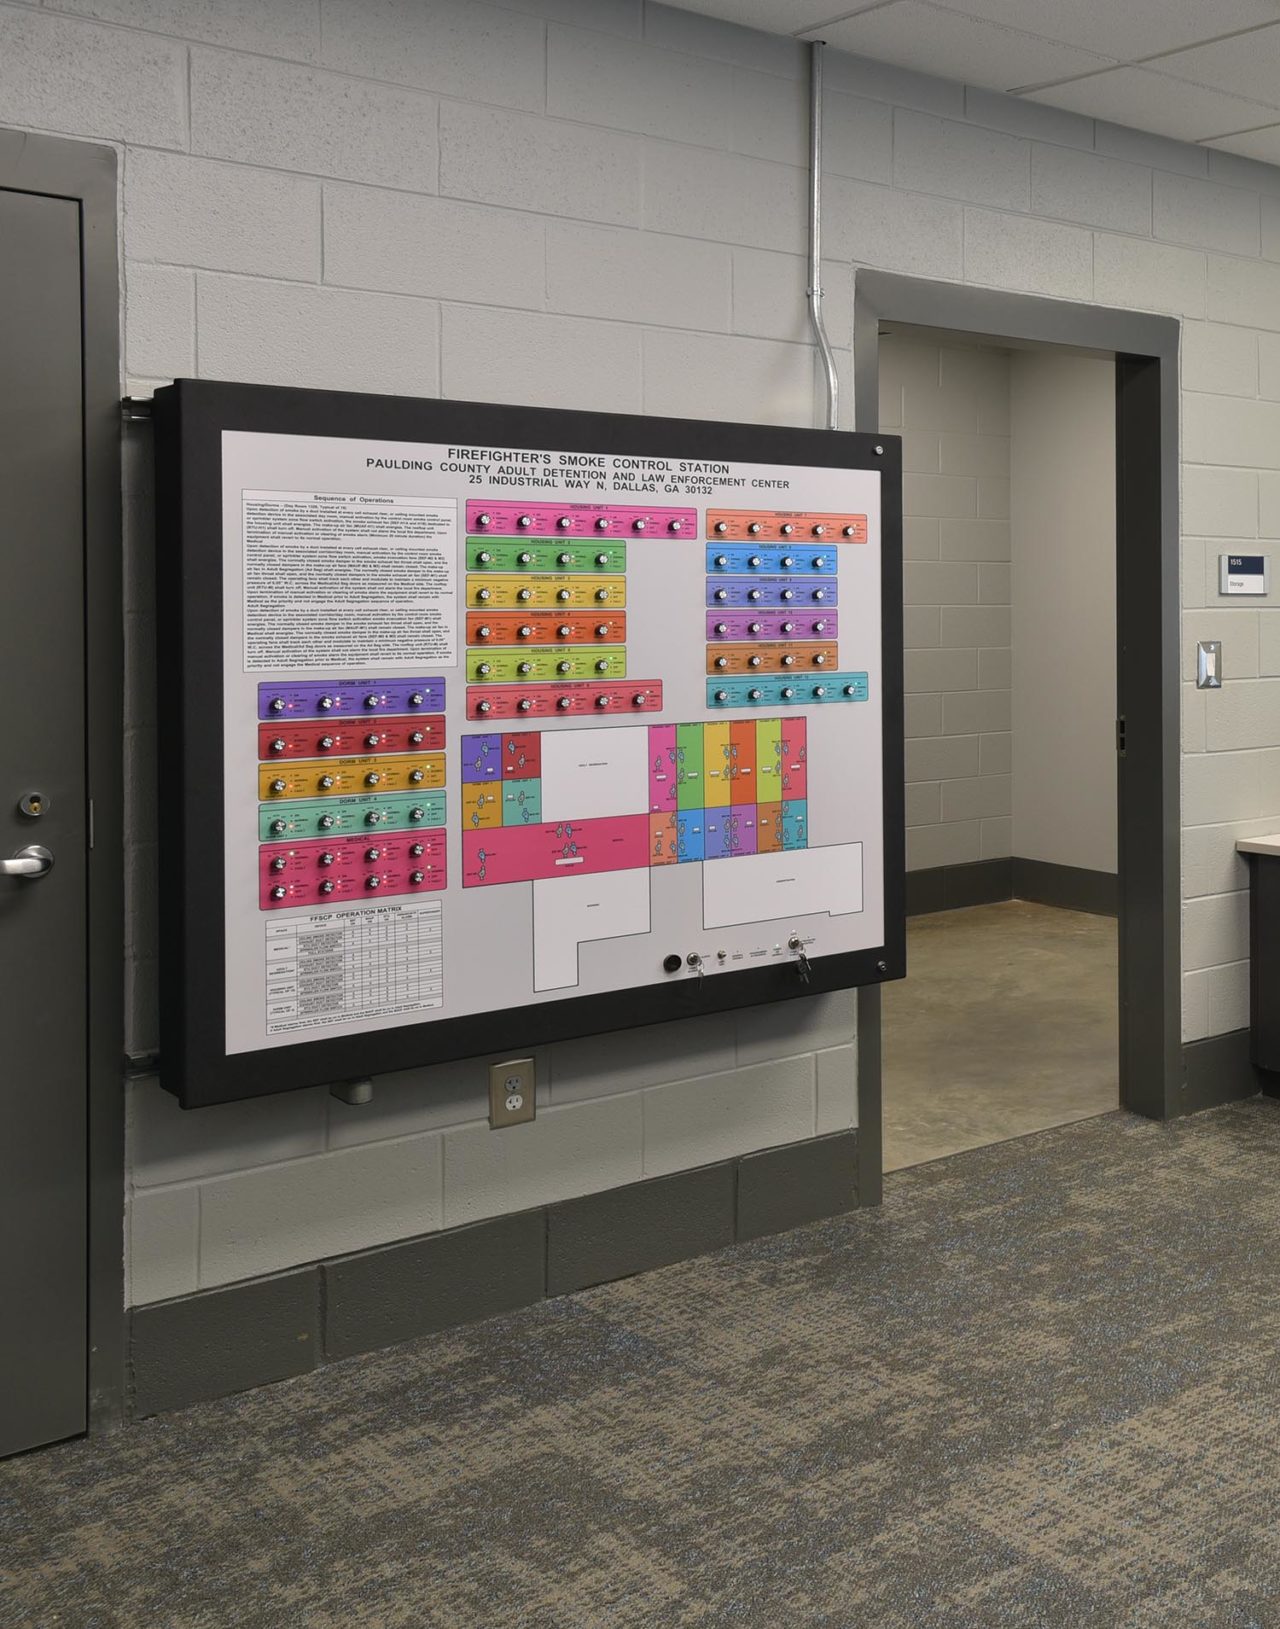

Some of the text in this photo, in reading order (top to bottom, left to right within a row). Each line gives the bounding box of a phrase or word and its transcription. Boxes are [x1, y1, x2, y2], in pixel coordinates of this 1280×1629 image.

[448, 448, 729, 474] FIREFIGHTER'S SMOKE CONTROL STATION
[367, 458, 789, 489] PAULDING COUNTY ADULT DETENTION AND LAW ENFORCEMENT CENTER
[469, 475, 712, 494] 25 INDUSTRIAL WAY N, DALLAS, GA 30132
[313, 495, 346, 503] Sequence
[1230, 558, 1242, 566] 1515
[310, 906, 402, 922] FFSCP OPERATION MATRIX
